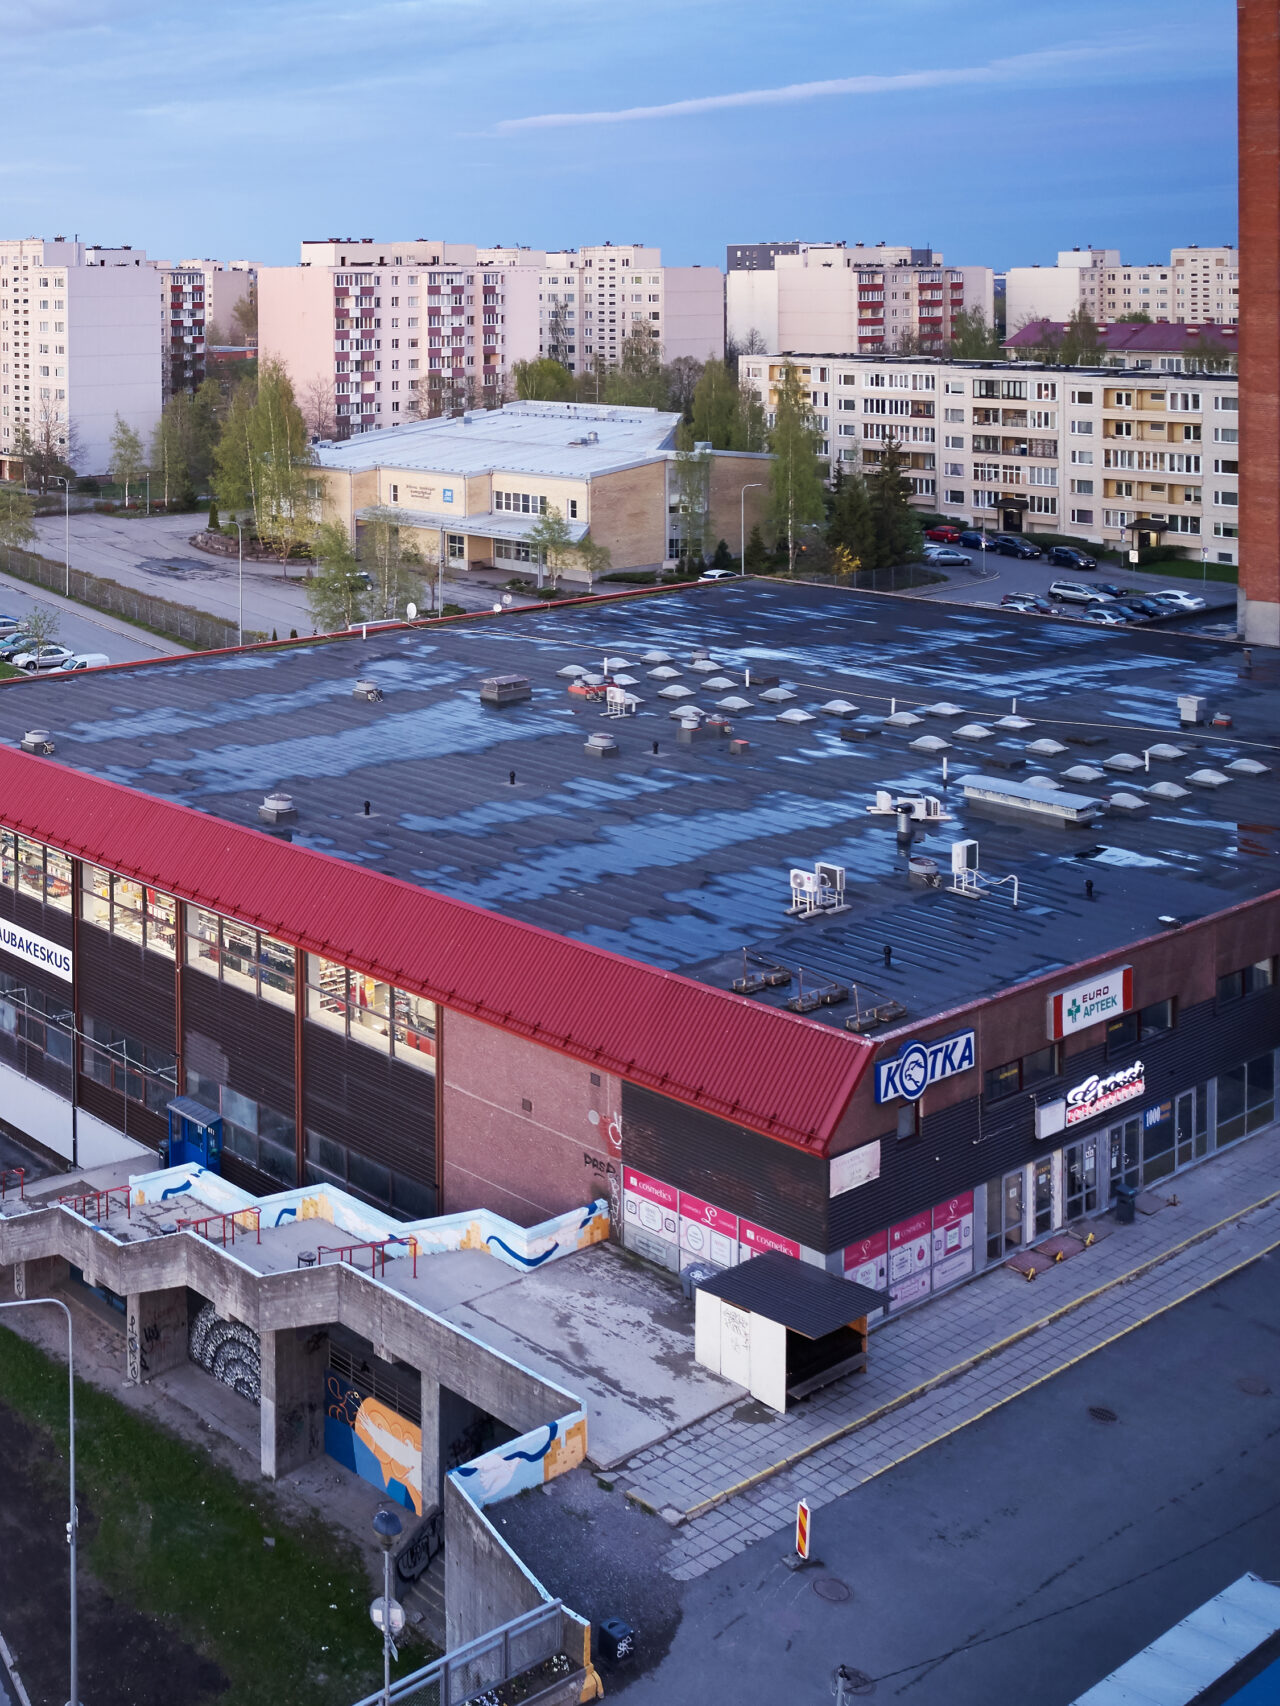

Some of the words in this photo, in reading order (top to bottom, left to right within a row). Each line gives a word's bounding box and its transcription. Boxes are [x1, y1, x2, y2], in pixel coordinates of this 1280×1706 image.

[1082, 986, 1110, 1004] EURO
[1083, 994, 1118, 1018] APTEEK
[882, 1037, 973, 1098] KOTKA
[638, 1182, 672, 1202] cosmetics
[756, 1234, 794, 1258] cosmetics
